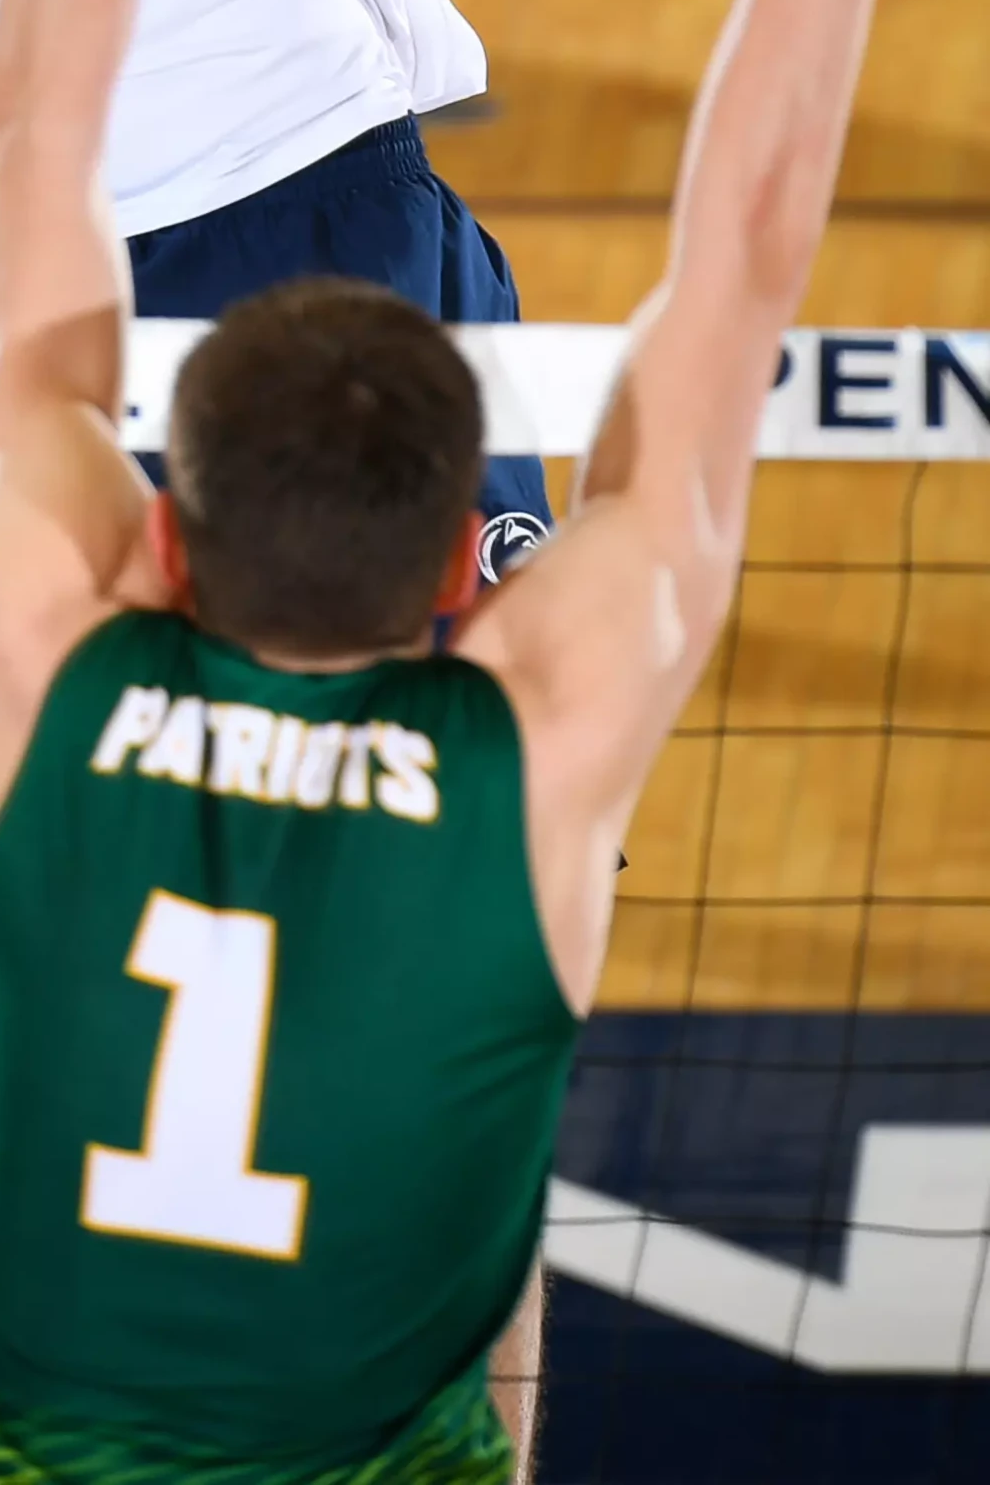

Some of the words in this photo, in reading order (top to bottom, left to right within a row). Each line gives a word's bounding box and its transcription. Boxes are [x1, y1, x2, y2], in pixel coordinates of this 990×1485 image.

[771, 337, 990, 429] EN
[90, 684, 440, 825] PATRIOTS
[78, 887, 308, 1261] 1
